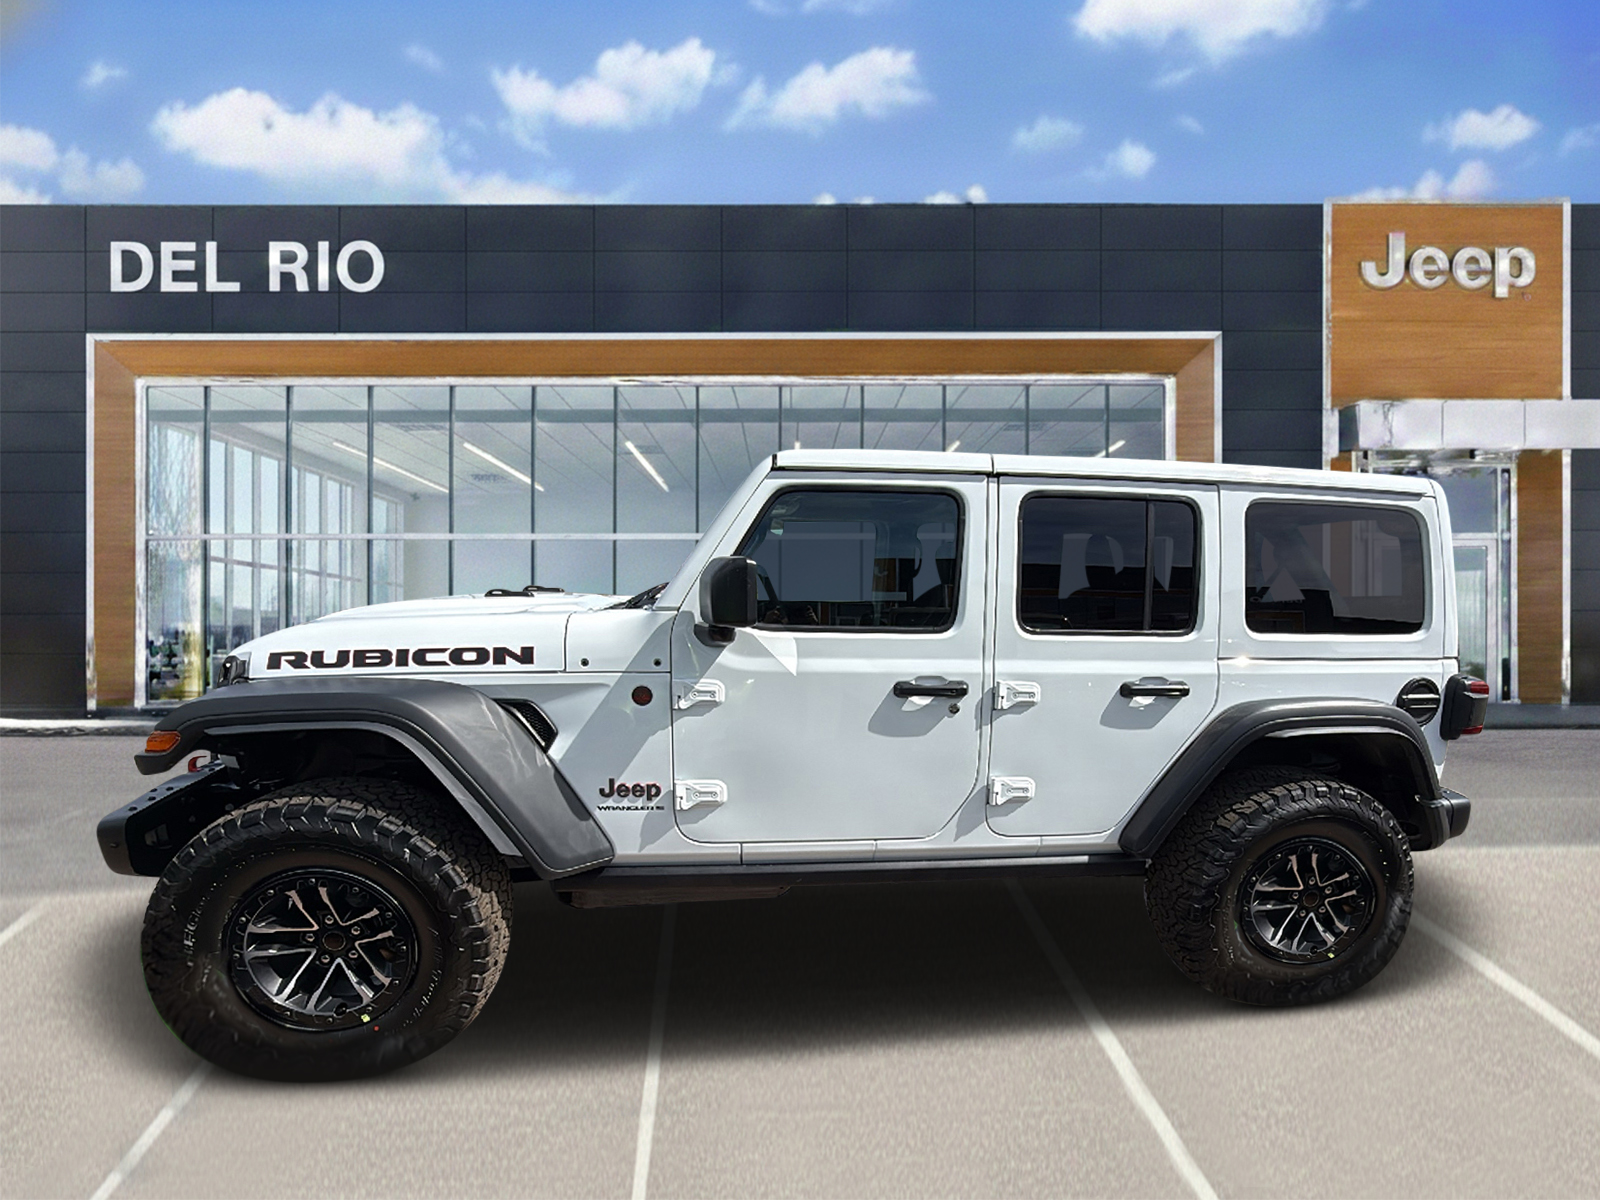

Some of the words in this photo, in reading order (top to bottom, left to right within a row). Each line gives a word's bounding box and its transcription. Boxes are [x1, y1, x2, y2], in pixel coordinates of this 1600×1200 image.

[110, 241, 241, 292] DEL
[268, 240, 385, 293] RIO
[1360, 231, 1536, 298] Jeep
[266, 646, 535, 670] RUBICON
[598, 777, 662, 801] Jeep
